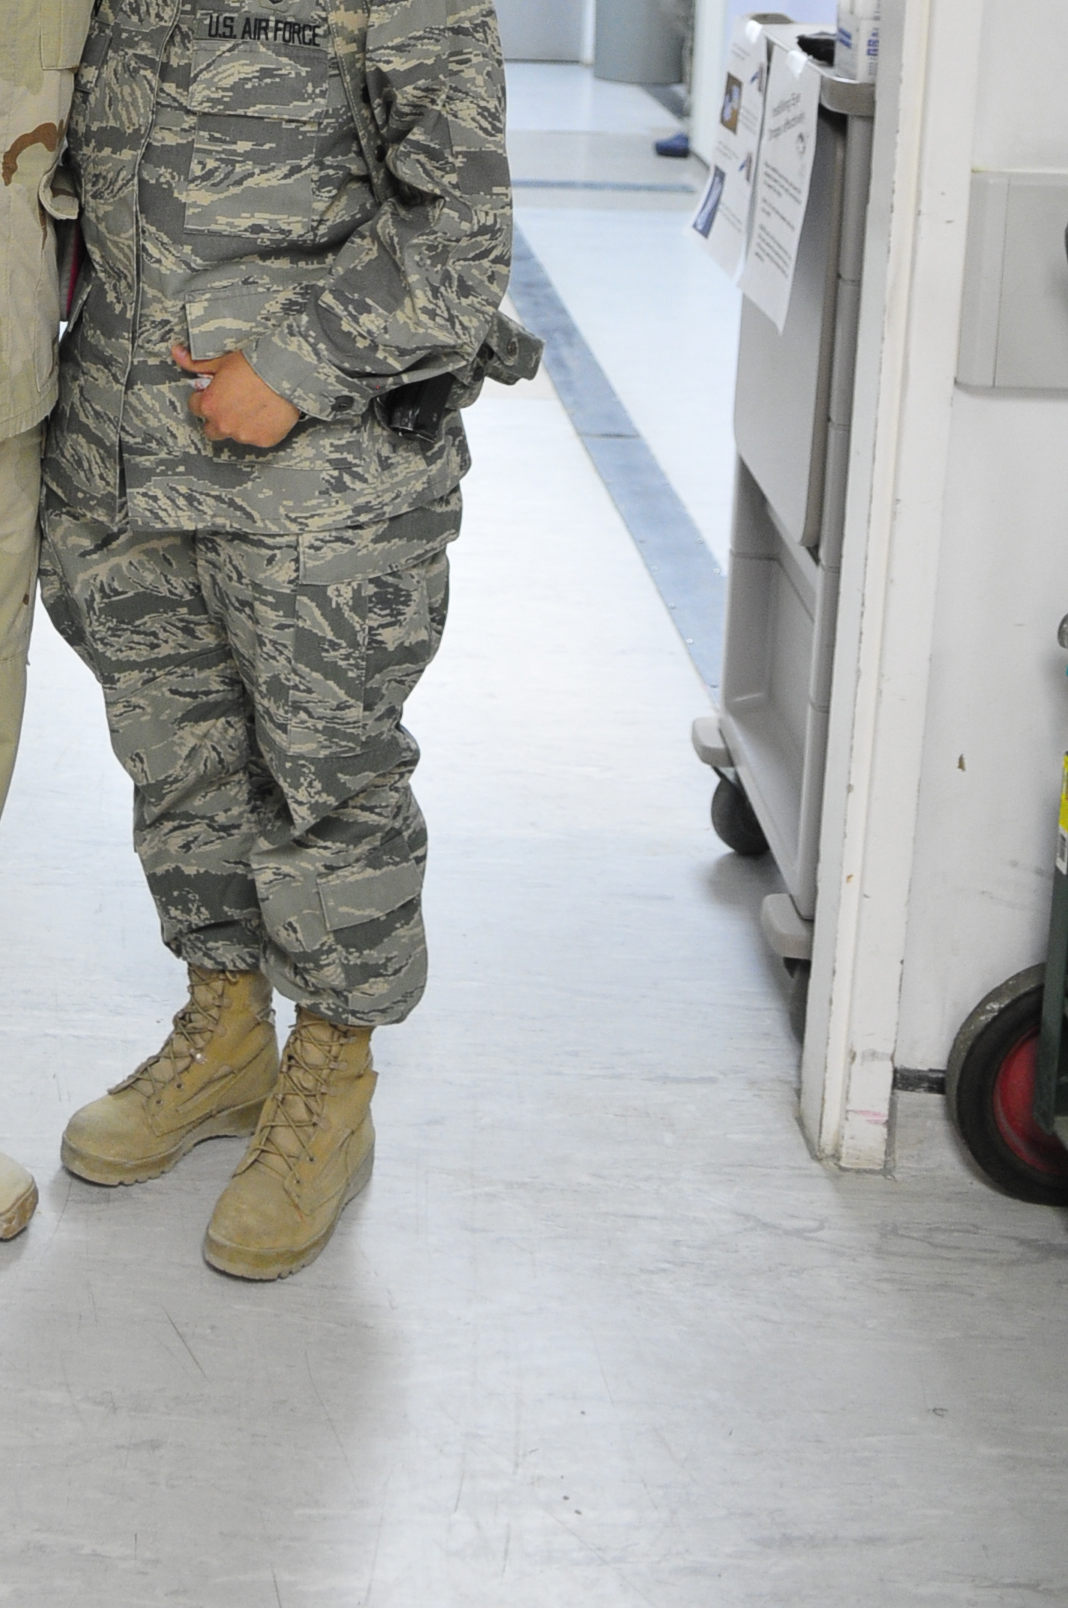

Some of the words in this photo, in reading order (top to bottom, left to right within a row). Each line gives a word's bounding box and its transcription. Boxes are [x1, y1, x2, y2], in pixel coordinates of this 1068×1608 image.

[208, 14, 237, 39] U.S.
[241, 16, 269, 41] AIR
[273, 20, 321, 47] FORCE
